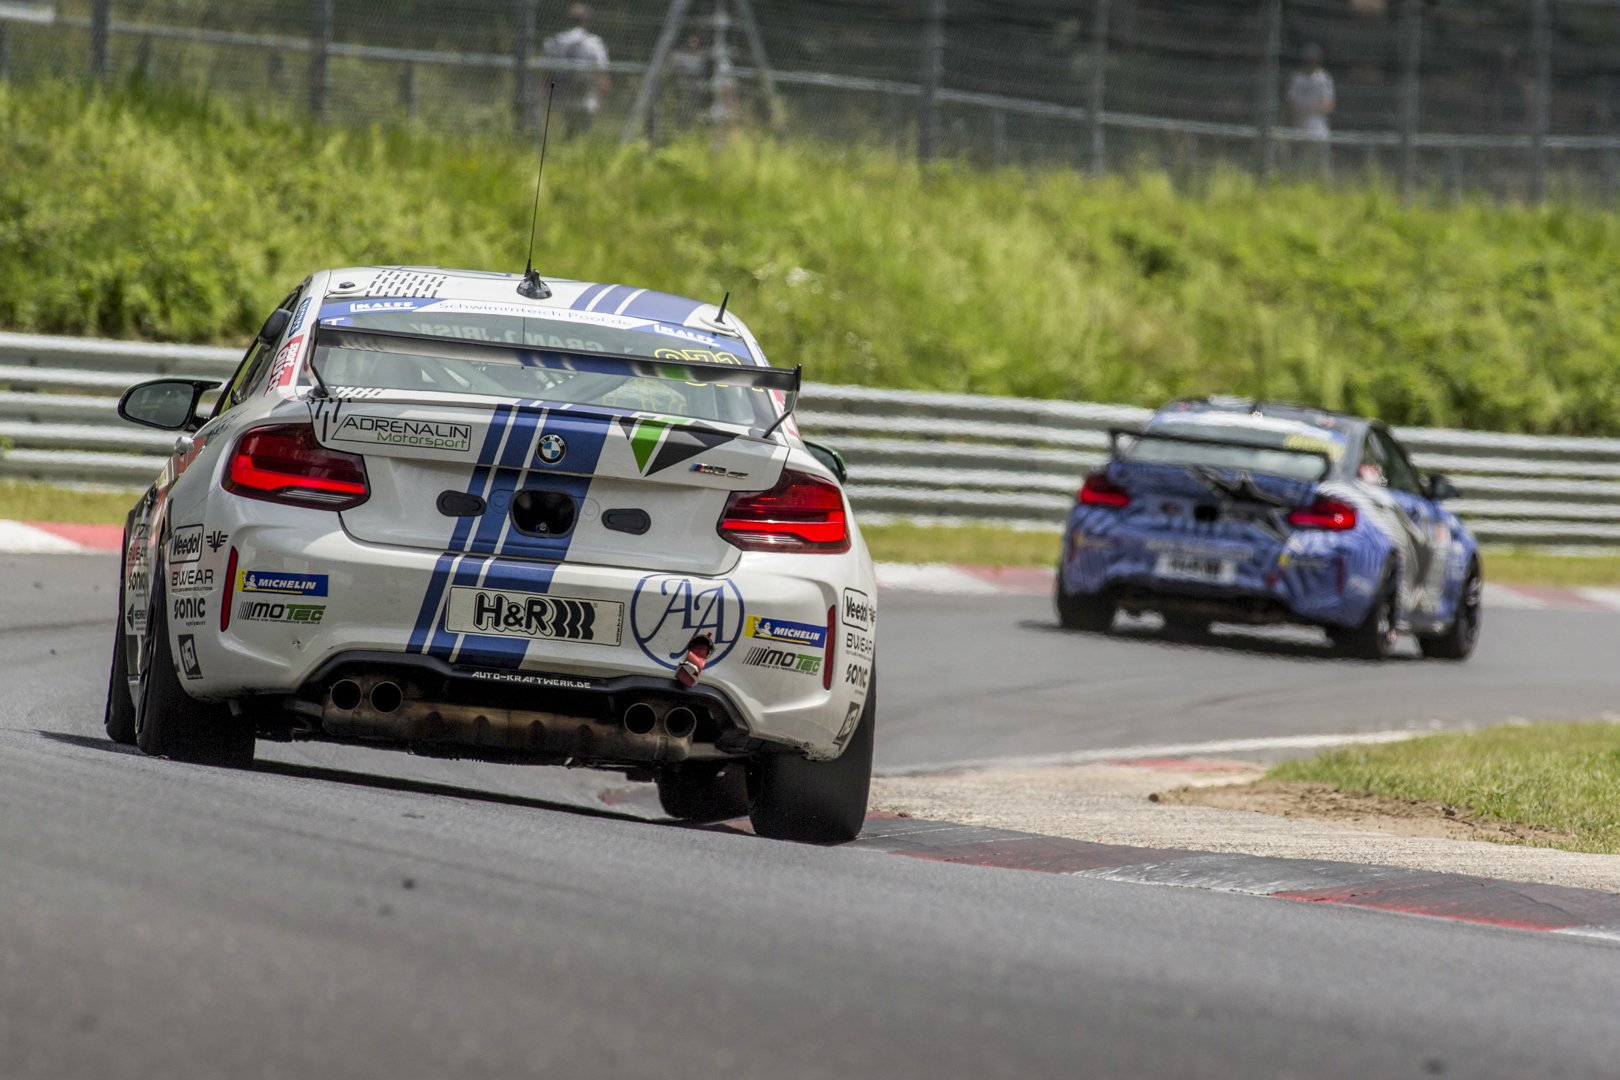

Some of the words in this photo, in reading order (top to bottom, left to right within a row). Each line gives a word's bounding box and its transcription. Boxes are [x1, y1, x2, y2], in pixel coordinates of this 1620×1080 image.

[439, 302, 632, 326] Schwimmteich-Pool.de
[343, 416, 469, 439] ADRENALIN
[377, 431, 467, 448] Motorsport
[173, 532, 201, 556] Veedol
[171, 568, 214, 587] BWEAR
[258, 578, 317, 590] MICHELIN
[475, 593, 549, 632] H&R
[773, 626, 821, 641] MICHELIN
[472, 671, 591, 688] AUTO-KRAFTWERK.DE
